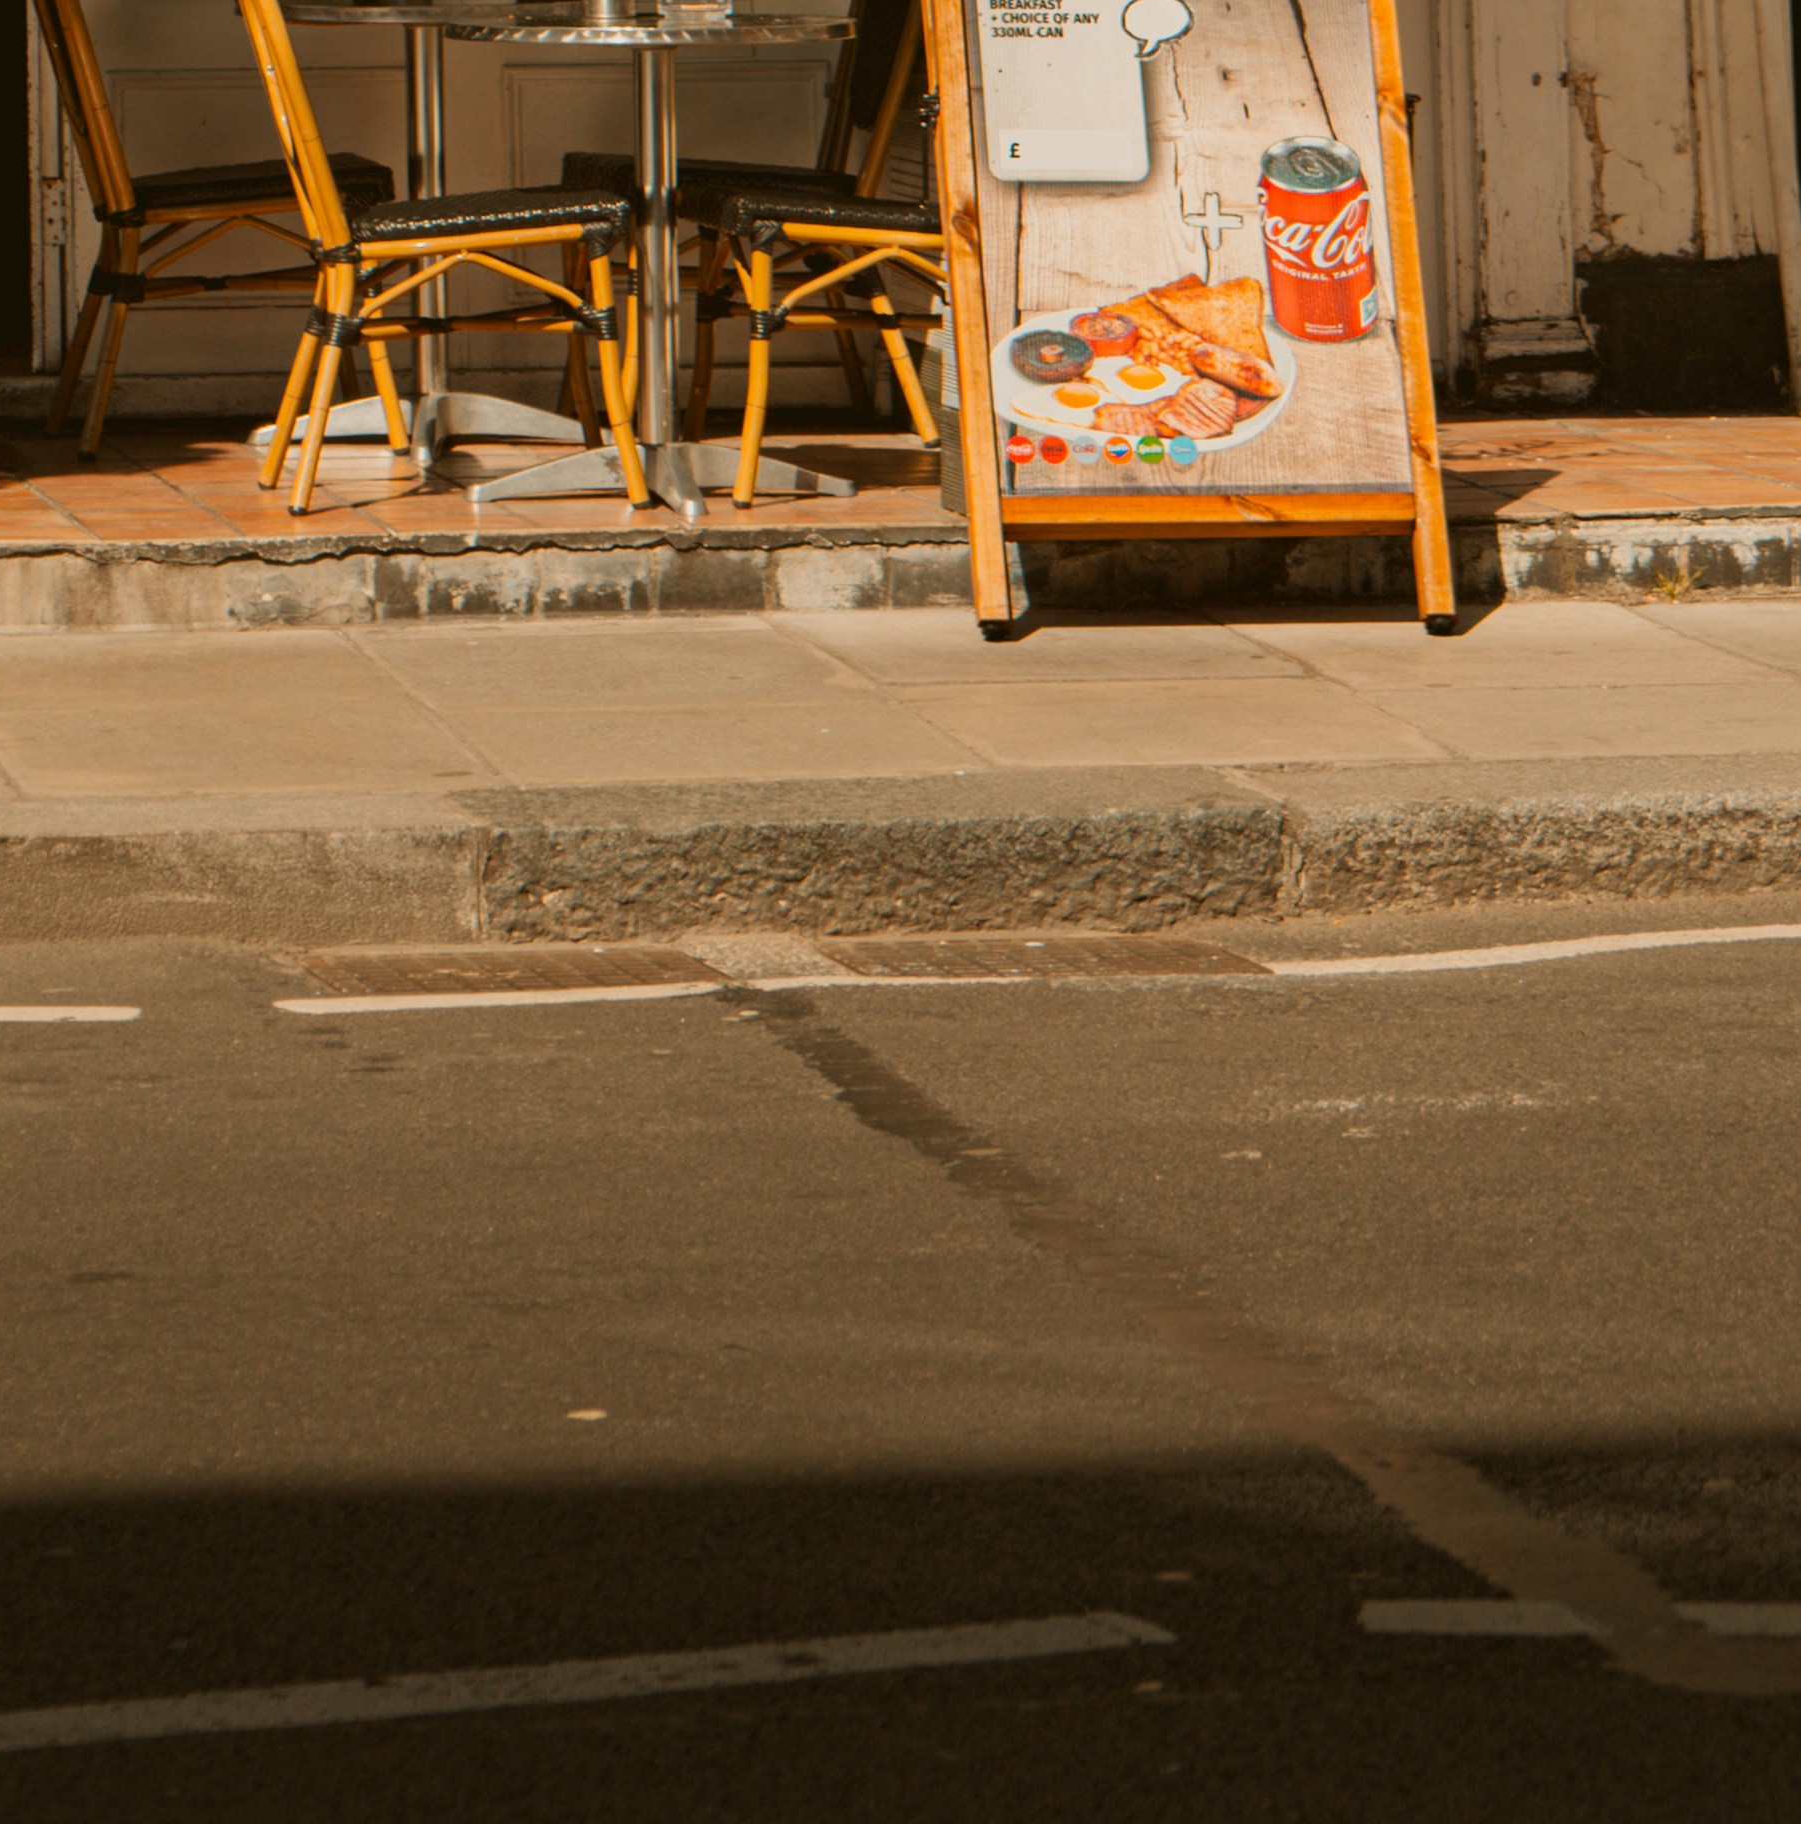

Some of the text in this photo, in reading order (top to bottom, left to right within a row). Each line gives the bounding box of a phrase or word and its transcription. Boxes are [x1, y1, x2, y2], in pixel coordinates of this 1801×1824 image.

[1001, 12, 1050, 24] CHOICE
[1053, 12, 1070, 24] OF
[1073, 12, 1100, 24] ANY
[991, 26, 1064, 38] 330ML CAN
[1009, 142, 1021, 159] £
